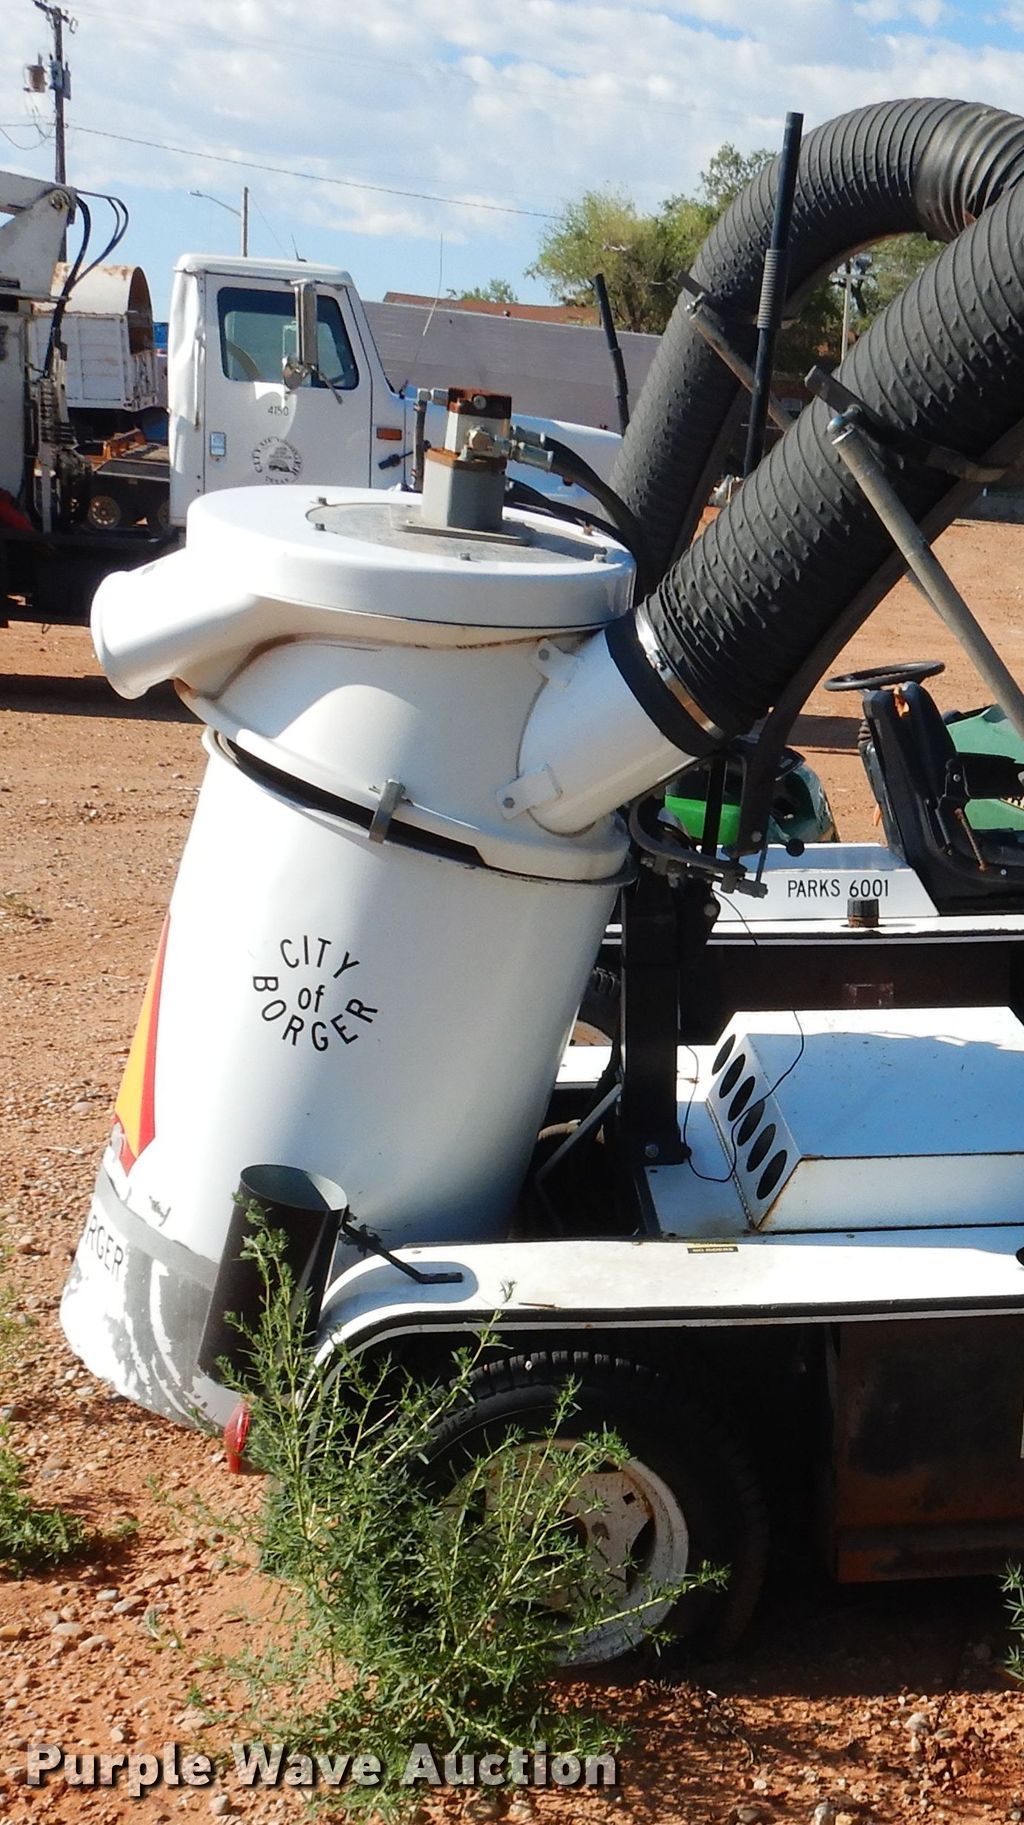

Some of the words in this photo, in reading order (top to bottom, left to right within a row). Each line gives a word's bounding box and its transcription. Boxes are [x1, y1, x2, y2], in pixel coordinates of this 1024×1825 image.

[787, 879, 841, 898] PARKS
[849, 879, 889, 898] 6001
[279, 934, 360, 979] CITY
[252, 975, 379, 1051] BORGER
[298, 984, 325, 1013] of
